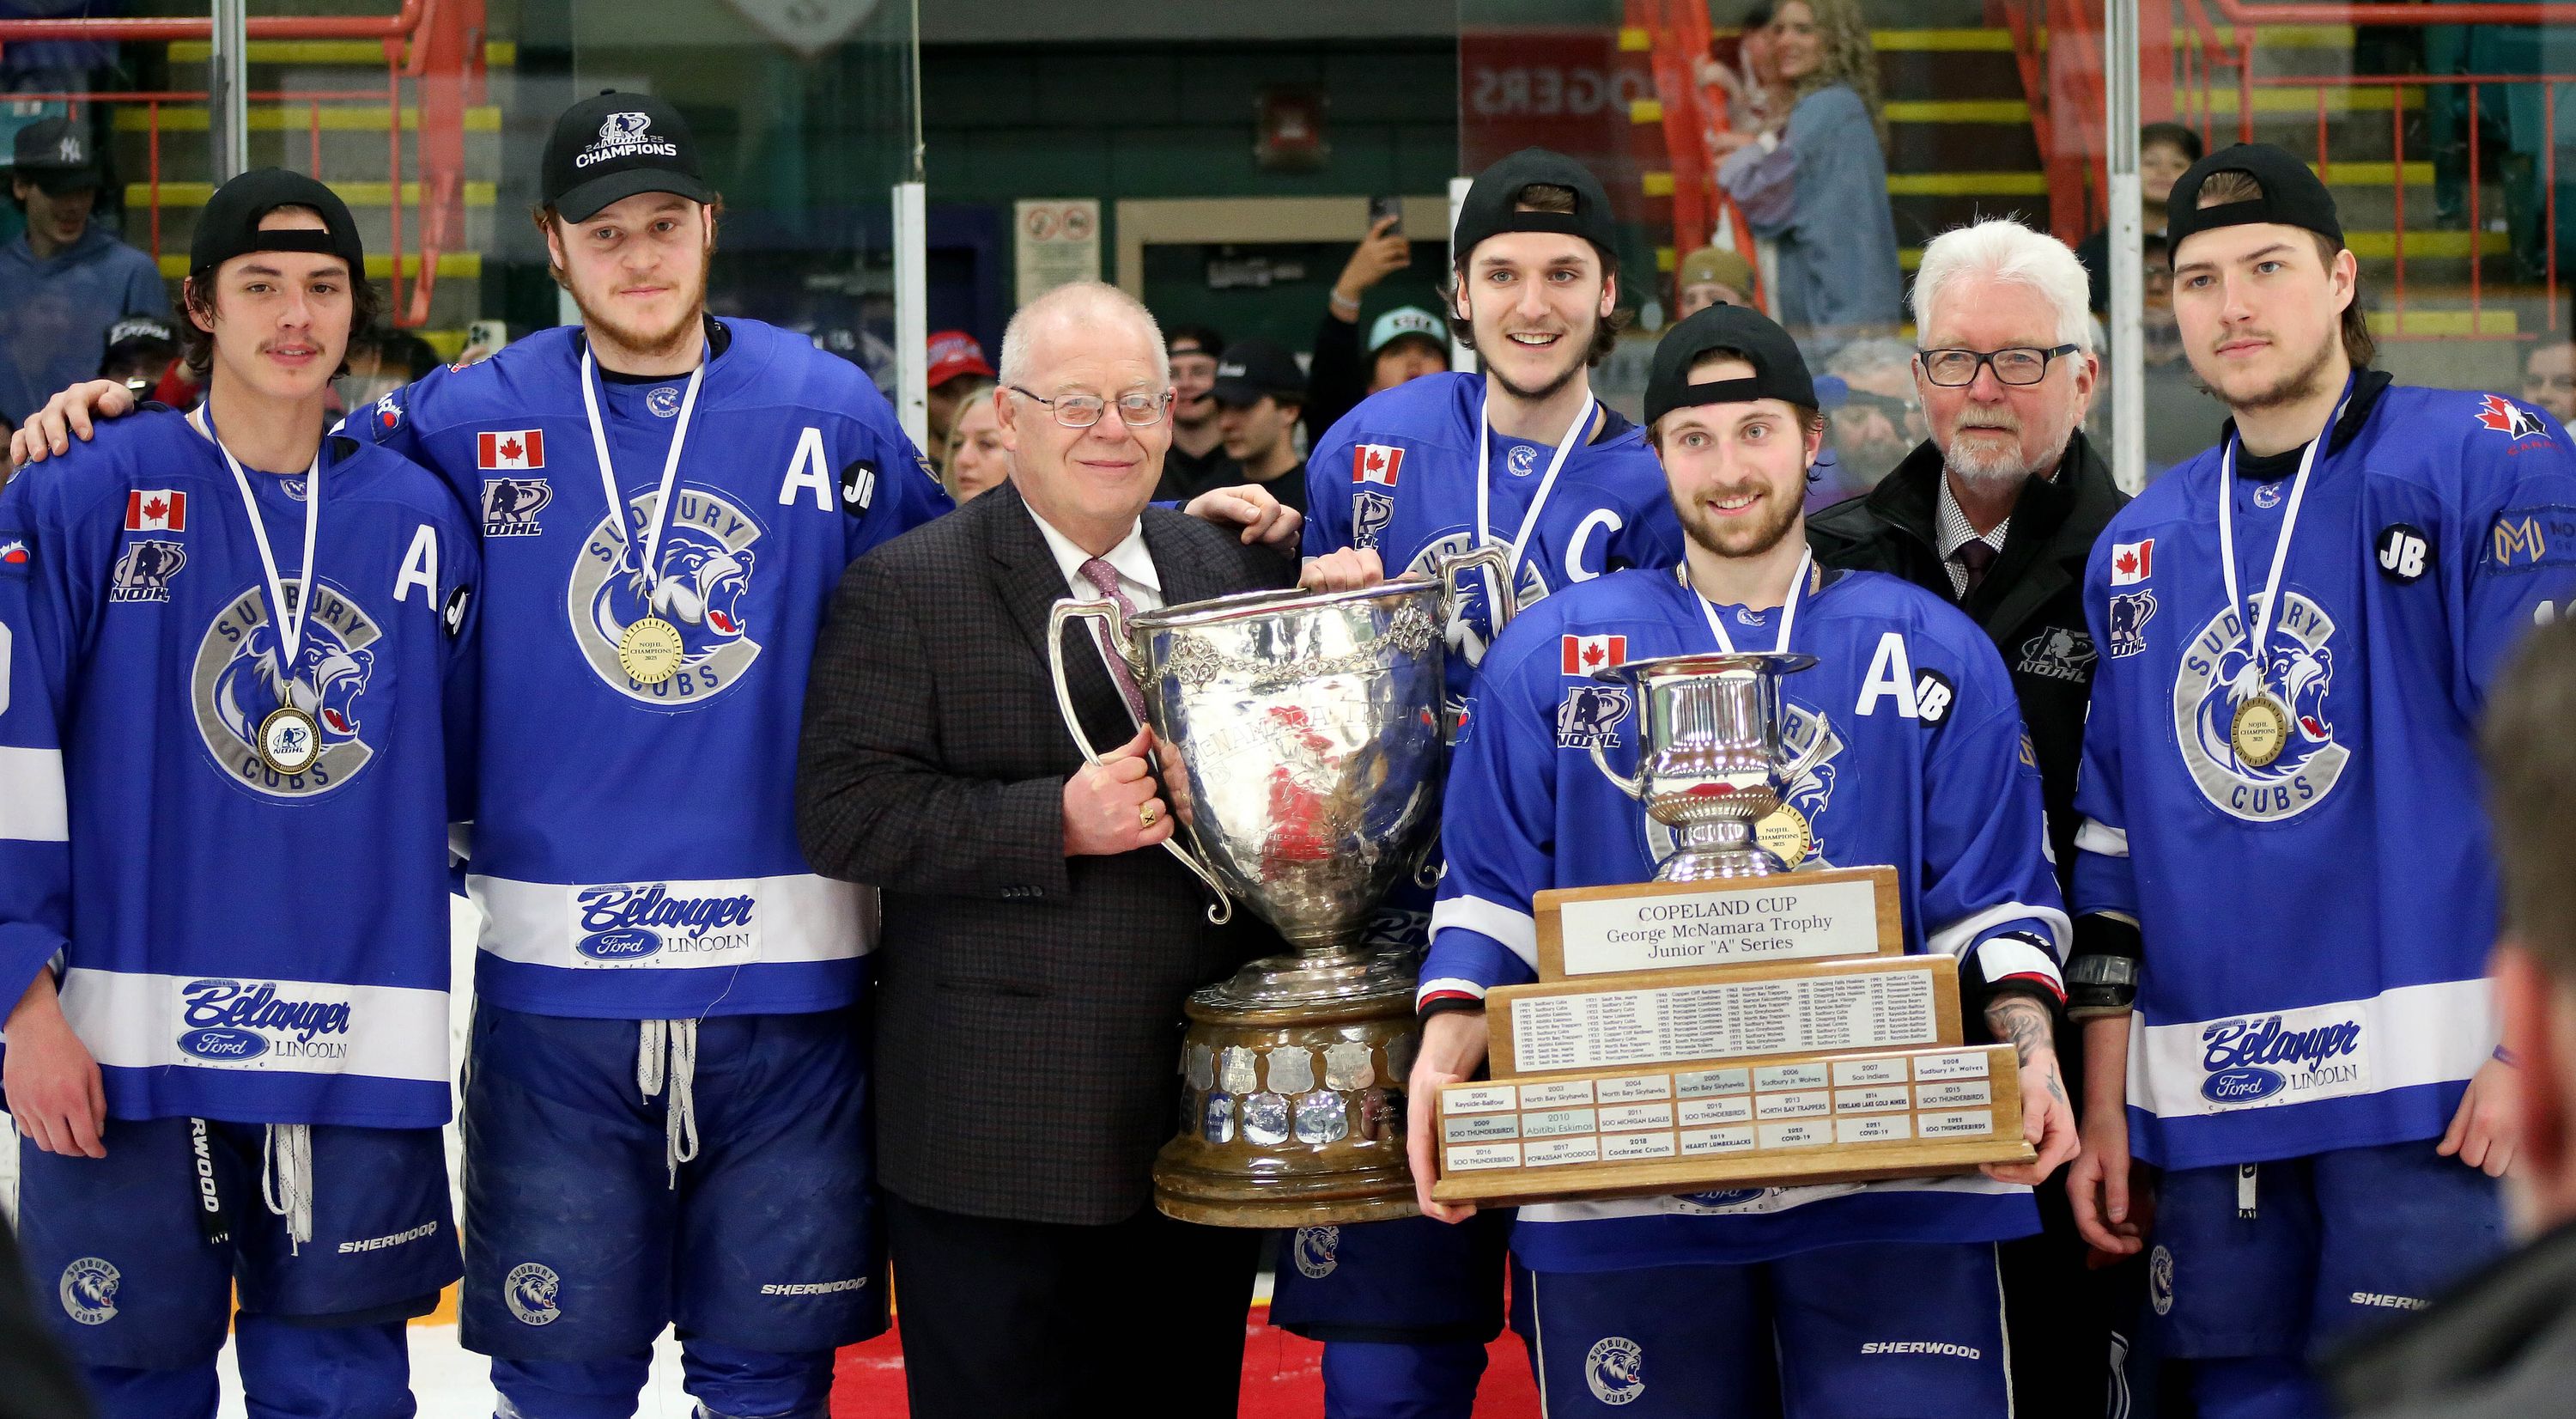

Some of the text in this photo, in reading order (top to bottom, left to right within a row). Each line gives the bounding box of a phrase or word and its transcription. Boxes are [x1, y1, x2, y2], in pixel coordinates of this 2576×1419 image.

[575, 143, 677, 168] CHAMPIONS
[779, 427, 833, 512] A
[483, 521, 543, 537] OJHL
[589, 496, 744, 563] SUDURY
[1565, 508, 1623, 583] C
[2379, 531, 2427, 578] JB
[393, 524, 438, 612] A
[218, 586, 366, 643] SUBURY
[2111, 638, 2147, 659] OJHL
[2187, 601, 2321, 676] SUDBRY
[1855, 632, 1919, 718] A
[2017, 660, 2087, 683] NOJHL
[2233, 776, 2313, 813] CUBS
[577, 883, 755, 939] Bélanger
[1639, 897, 1797, 922] COPELAND CUP
[1607, 915, 1832, 944] George McNamara Trophy
[596, 934, 750, 954] Ford LINCOLN
[1649, 938, 1793, 959] Junior "A" Series
[182, 979, 350, 1043] Bélanger
[196, 1032, 348, 1059] Ford LINCOLN
[2202, 1015, 2361, 1073] Bélanger
[1715, 1081, 1745, 1090] Skyhawks
[1762, 1078, 1788, 1087] Sudbury
[2216, 1064, 2357, 1098] Ford LINCOLN
[1455, 1099, 1504, 1108] Rayside-Balfour
[1546, 1093, 1556, 1102] Bay
[1939, 1093, 1984, 1102] THUNDERBIRDS
[1547, 1113, 1570, 1122] 2010
[1701, 1109, 1746, 1119] THUNDERBIRDS
[1467, 1127, 1515, 1136] THUNDERBIRDS
[1527, 1123, 1594, 1135] Abitibi Eskimos
[1608, 1147, 1643, 1156] Cochrane
[1710, 1139, 1751, 1148] LUMBERJACKS
[1470, 1155, 1515, 1165] THUNDERBIRDS
[1528, 1150, 1596, 1162] POWASSAN VOODOOS
[337, 1221, 438, 1254] SHERWOOD
[67, 1259, 115, 1277] SUDBURY
[509, 1265, 555, 1282] SUDBURY
[761, 1276, 867, 1296] SHERWOOD
[75, 1310, 103, 1322] CUBS
[521, 1313, 549, 1324] CUBS
[1589, 1339, 1637, 1361] SUDBURY
[1861, 1342, 1981, 1360] SHERWOOD
[1605, 1392, 1633, 1403] CUBS
